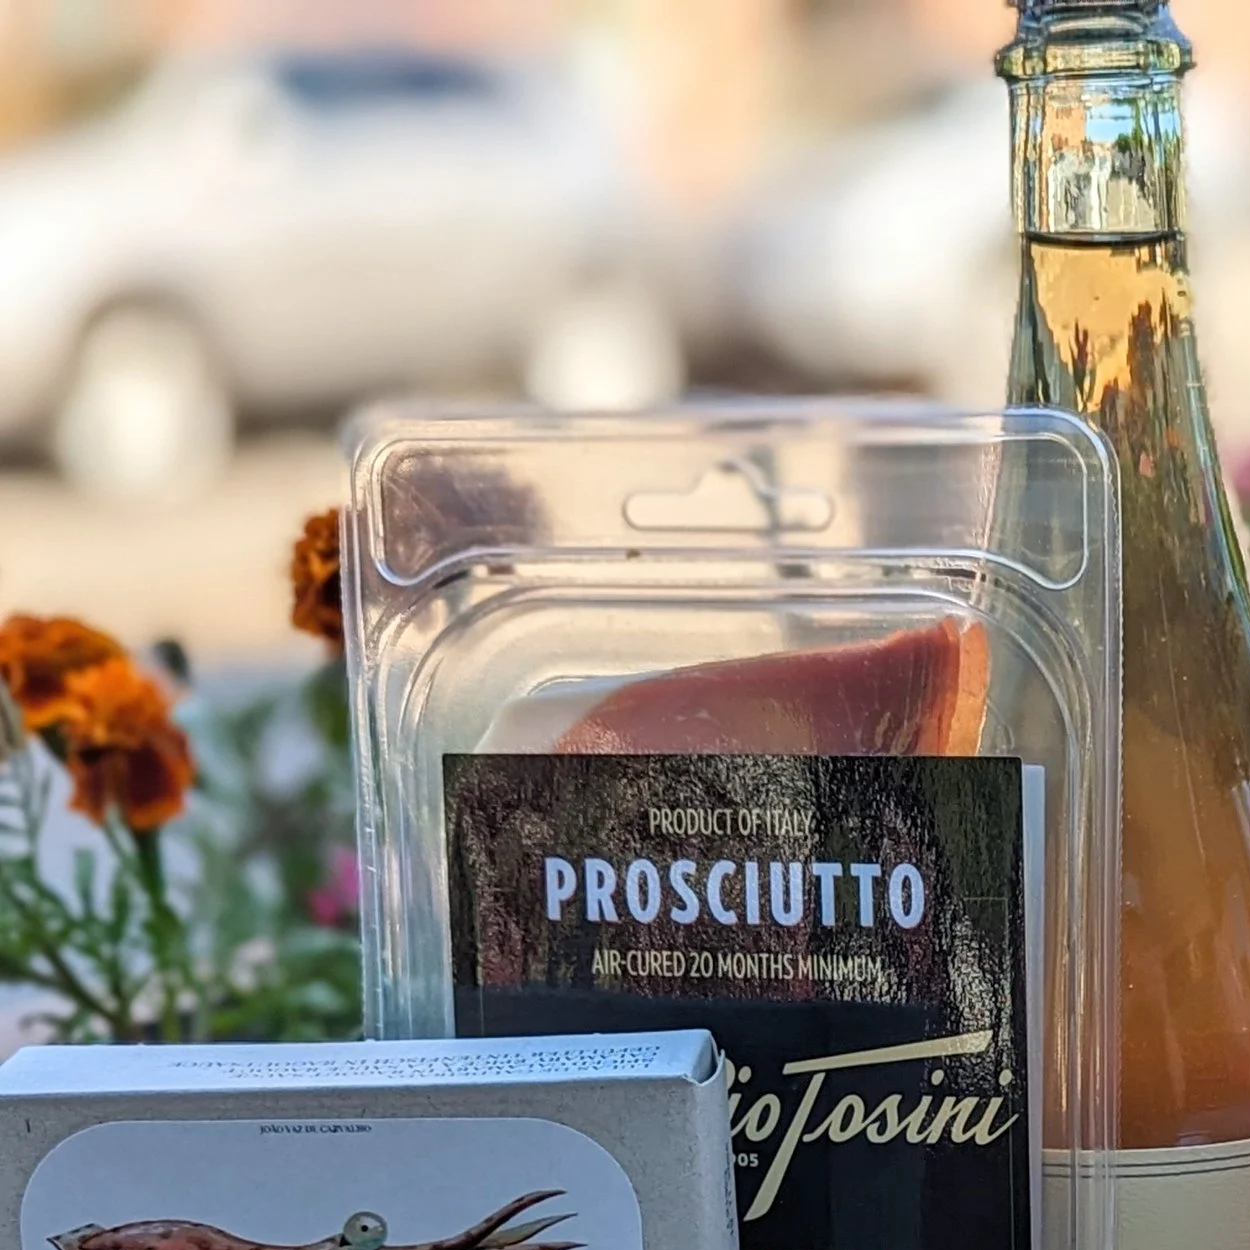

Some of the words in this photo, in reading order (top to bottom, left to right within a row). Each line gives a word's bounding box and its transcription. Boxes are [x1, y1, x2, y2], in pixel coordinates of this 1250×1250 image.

[649, 808, 731, 835] PRODUCT
[737, 810, 762, 836] OF
[765, 810, 813, 837] ITALY
[543, 856, 926, 930] PROSCIUTTO
[592, 949, 686, 978] AIR-CURED
[689, 951, 713, 979] 20
[717, 952, 794, 980] MONTHS
[797, 953, 882, 982] MINIMUM
[743, 1029, 1019, 1222] Tosini
